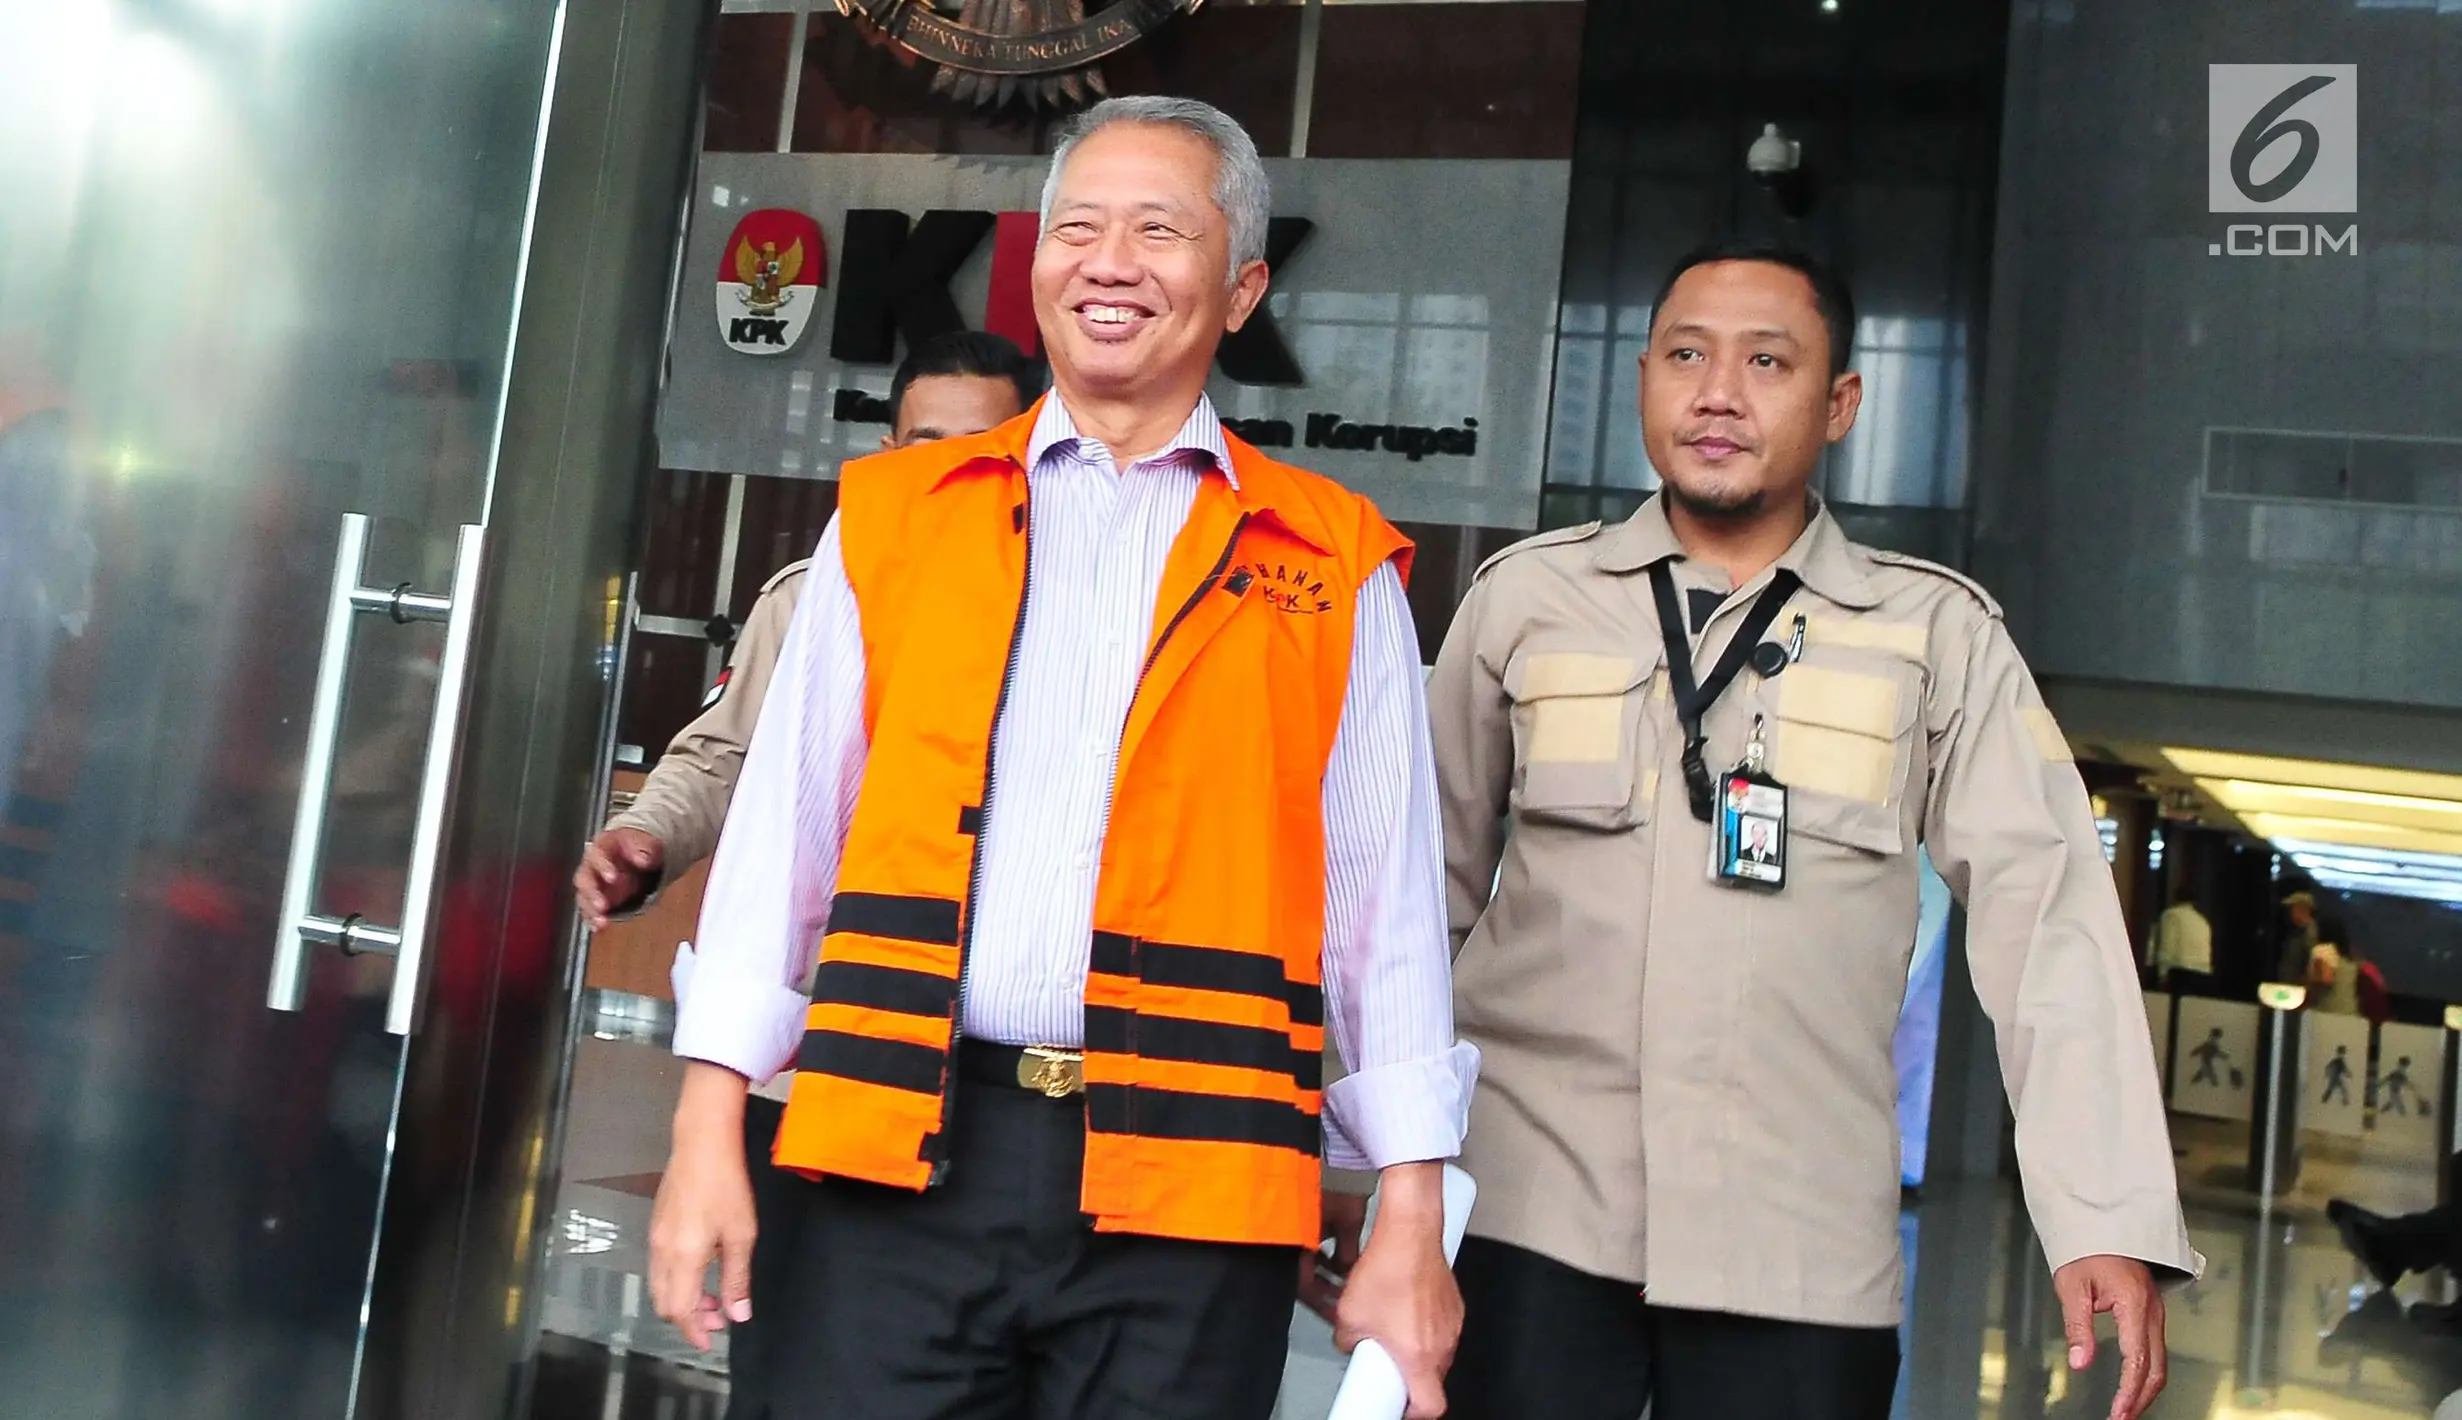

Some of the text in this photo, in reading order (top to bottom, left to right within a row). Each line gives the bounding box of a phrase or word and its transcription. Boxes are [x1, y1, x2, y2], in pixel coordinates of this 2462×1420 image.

[906, 15, 1132, 62] BHINNEKA TUNGGAL IKA
[729, 317, 789, 345] KPK
[1304, 412, 1479, 462] Korupsi
[1255, 563, 1333, 612] HANAN
